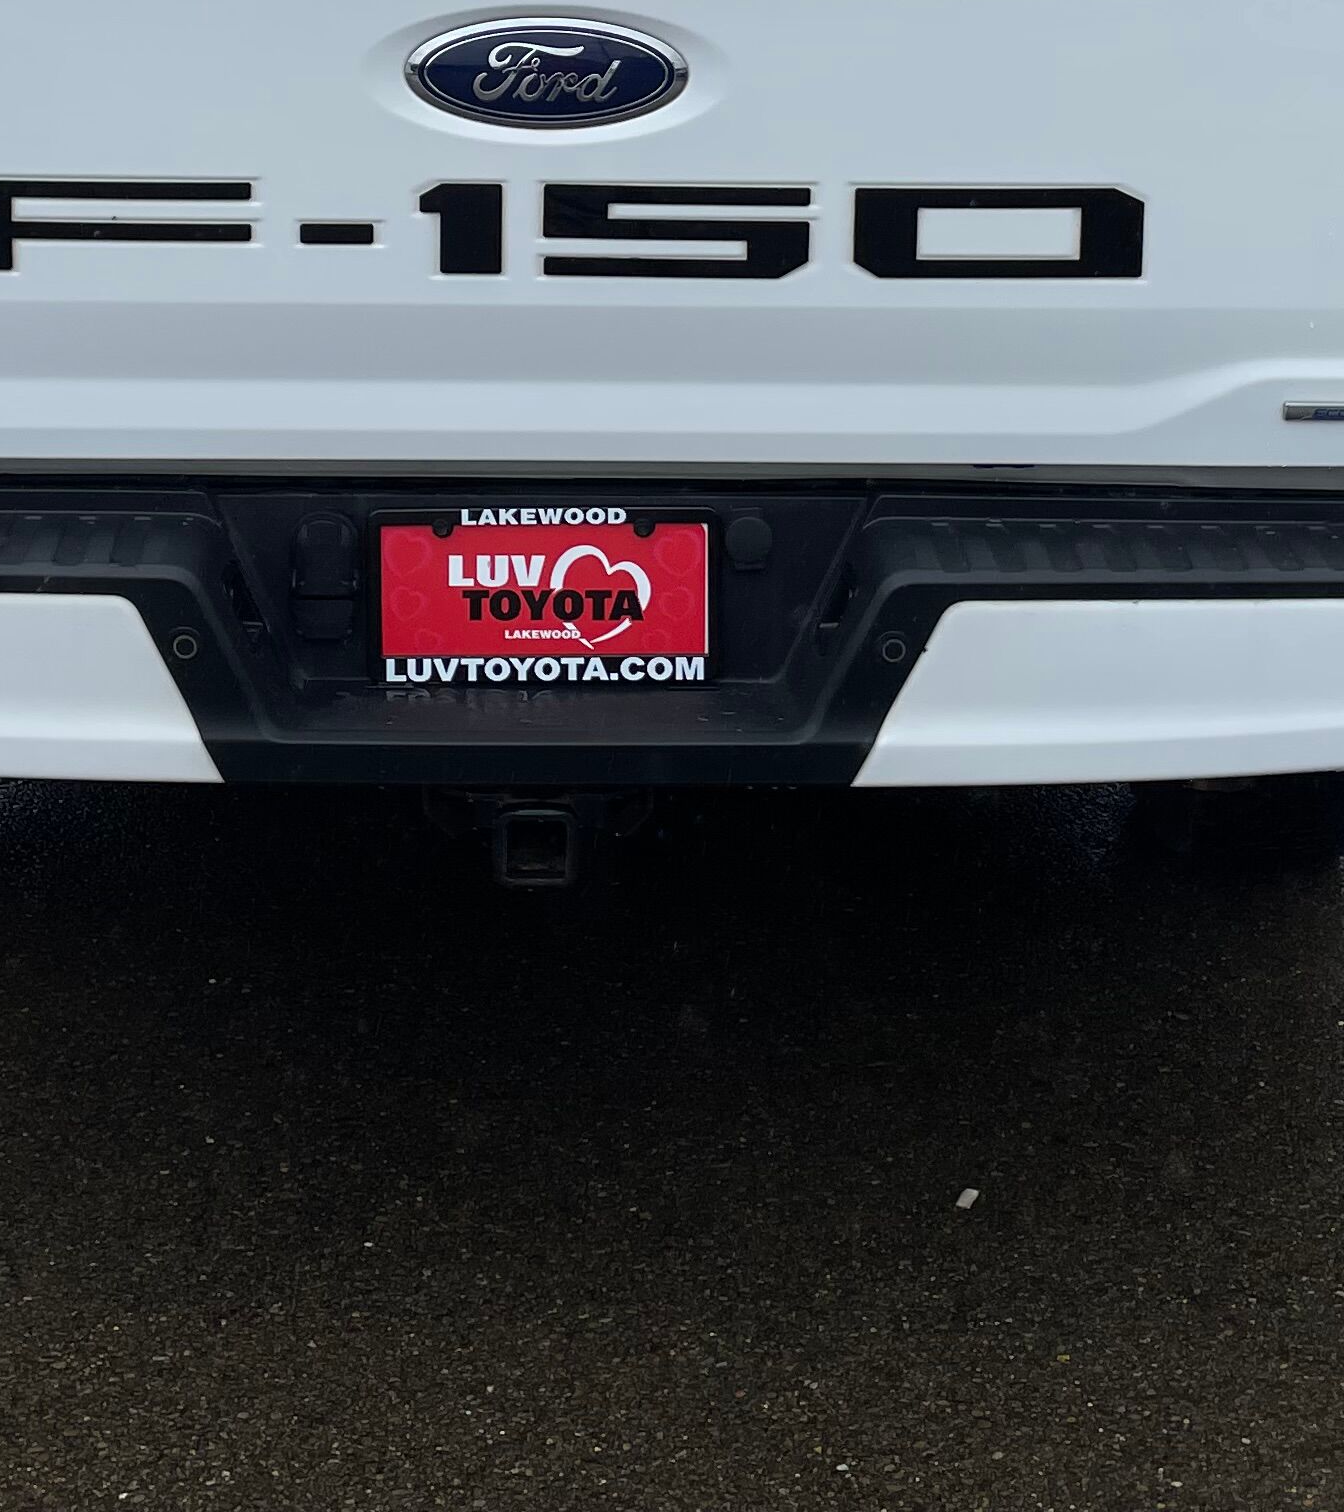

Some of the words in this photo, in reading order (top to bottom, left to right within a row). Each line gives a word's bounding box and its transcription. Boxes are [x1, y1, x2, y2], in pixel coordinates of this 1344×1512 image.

[472, 41, 623, 103] Ford
[461, 507, 627, 526] LAKEWOOD
[447, 554, 546, 587] LUV
[462, 589, 644, 621] TOYOTA
[504, 629, 581, 640] LAKEWOOD
[386, 656, 705, 682] LUVTOYOTA.COM
